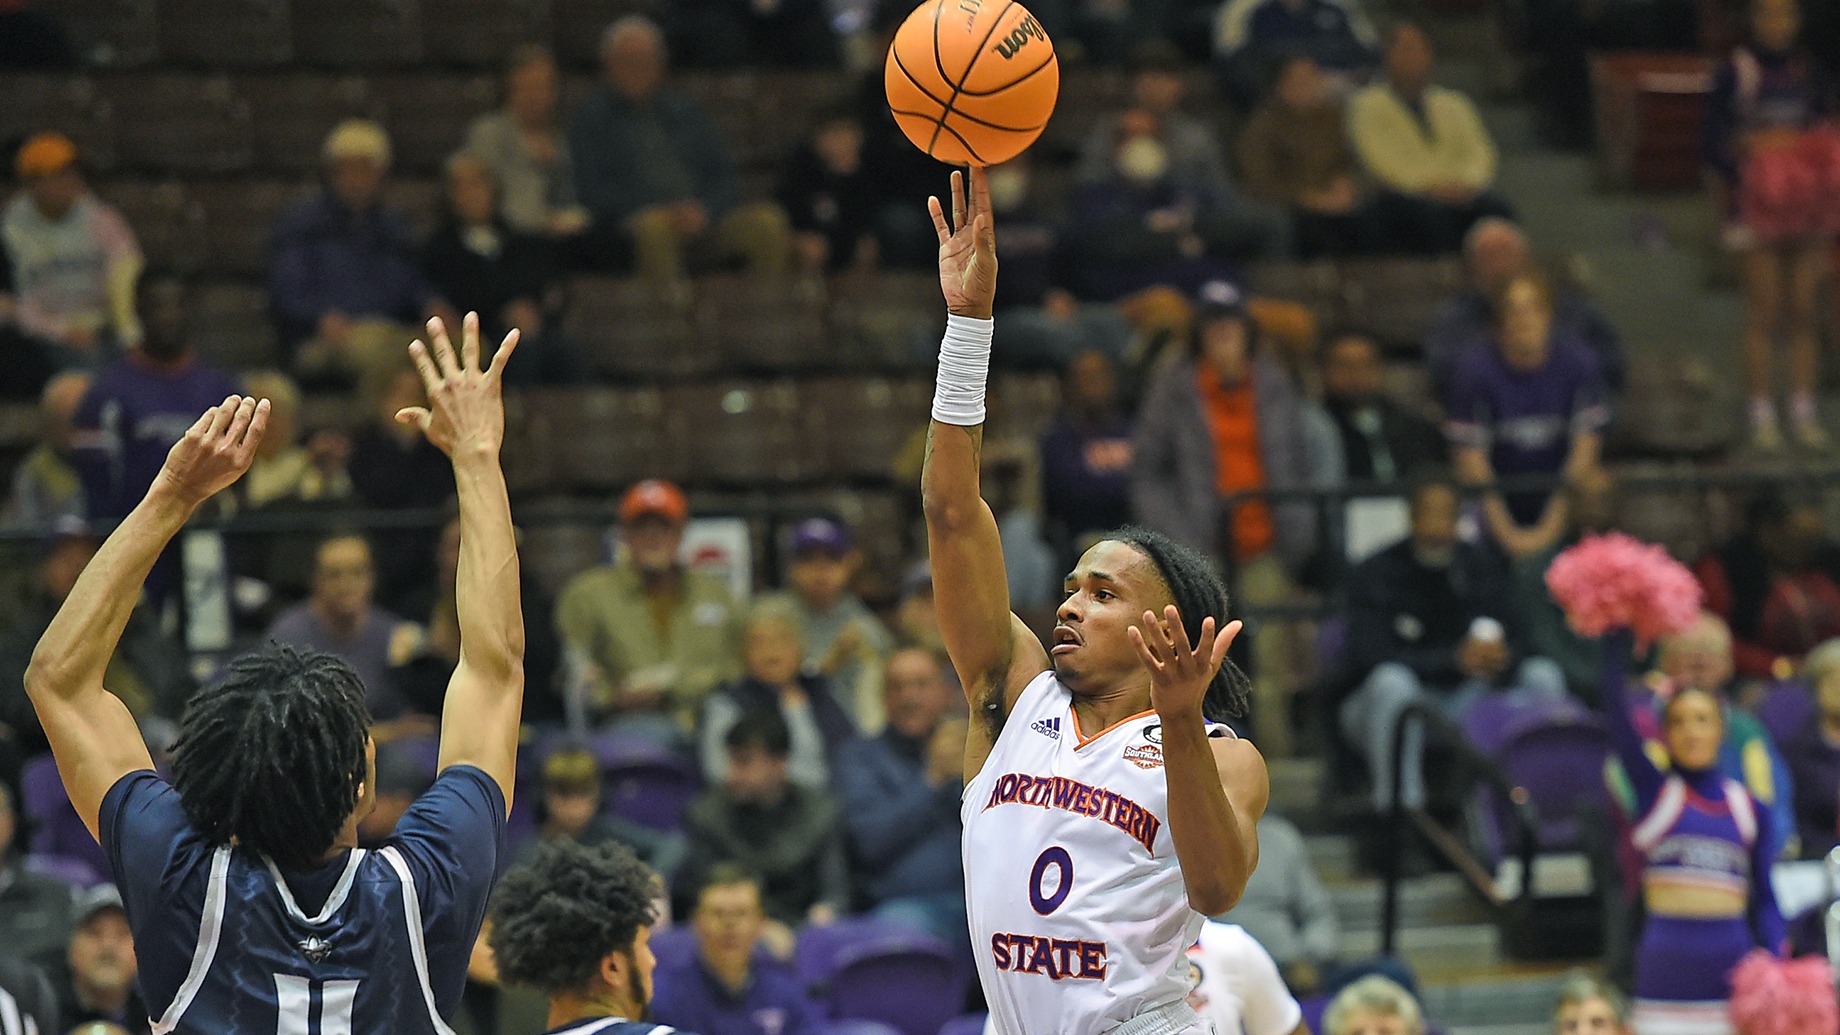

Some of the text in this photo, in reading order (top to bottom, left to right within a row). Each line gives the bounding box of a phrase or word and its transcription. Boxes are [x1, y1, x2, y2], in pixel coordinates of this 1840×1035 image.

[995, 13, 1045, 60] lson
[1030, 721, 1061, 740] adidas
[1124, 746, 1164, 763] SOUTHLAN
[981, 773, 1161, 858] NORTHWESTERN
[1029, 846, 1074, 916] 0
[991, 932, 1107, 982] STATE
